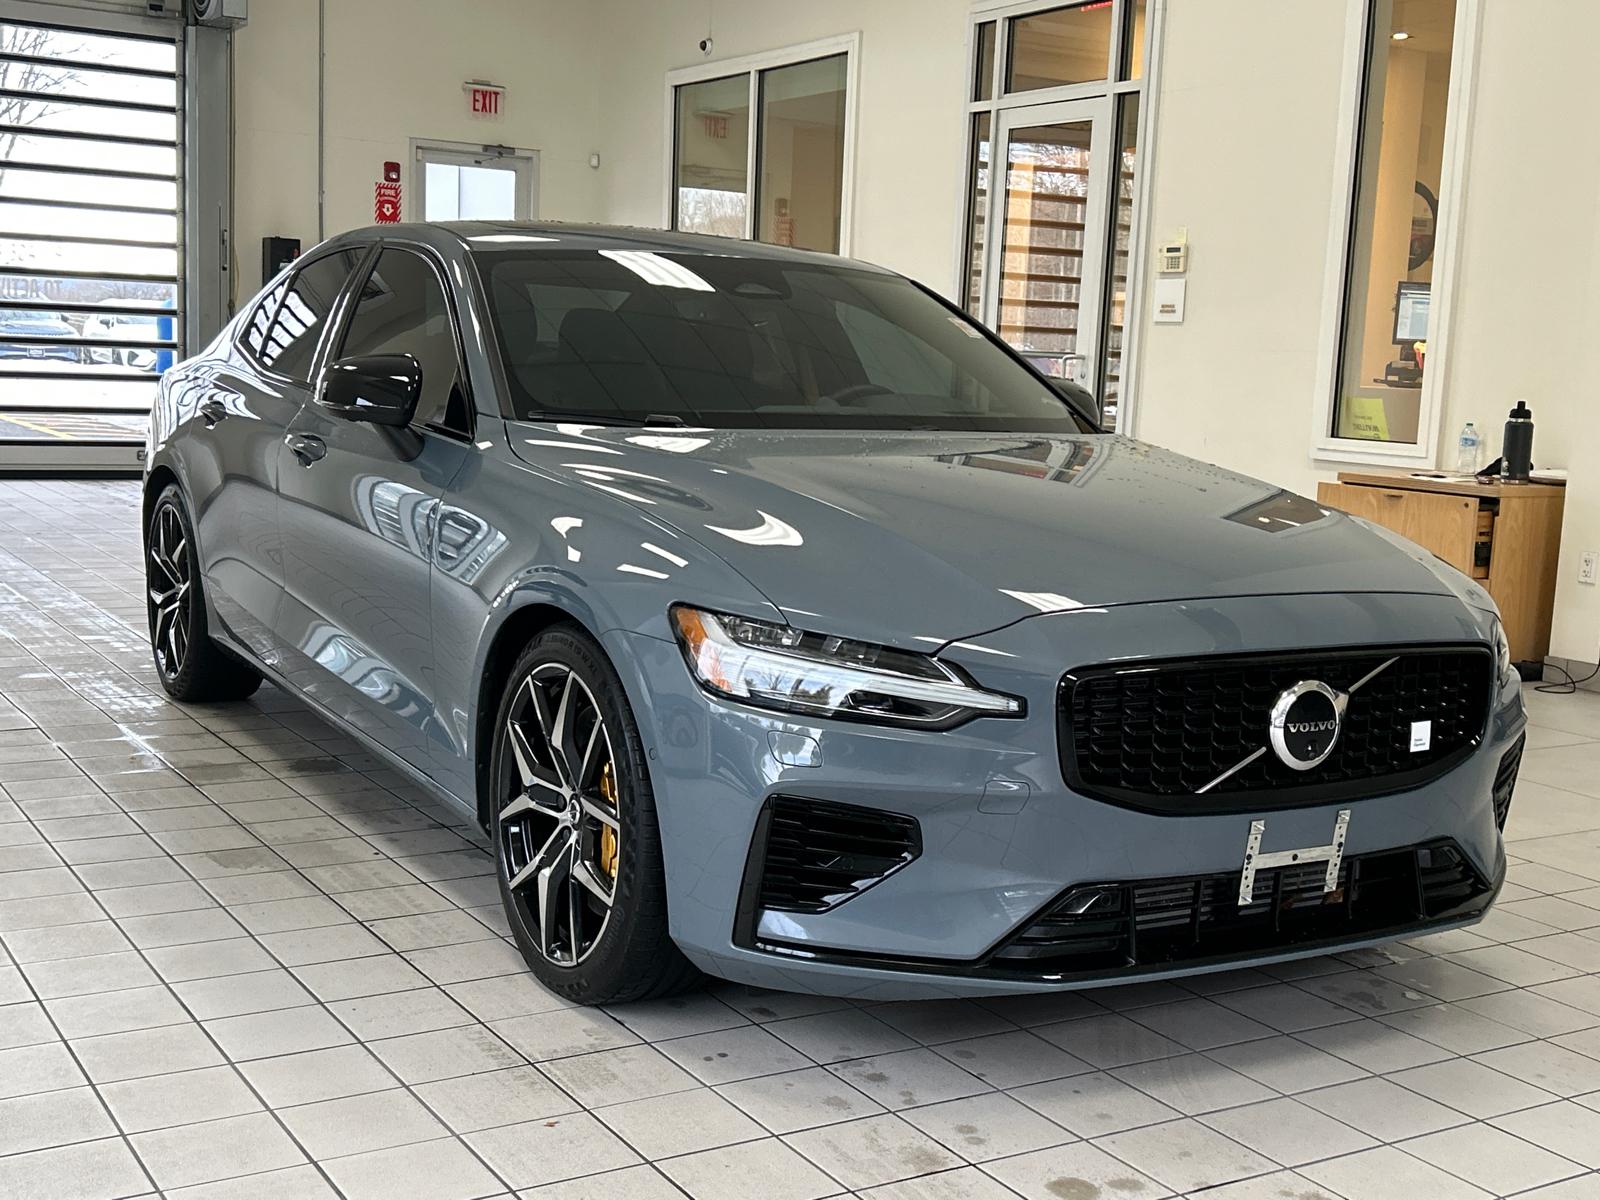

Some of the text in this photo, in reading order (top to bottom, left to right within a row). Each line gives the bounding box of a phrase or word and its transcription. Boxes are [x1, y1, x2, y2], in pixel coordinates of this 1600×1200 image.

[472, 89, 500, 114] EXIT
[380, 188, 396, 196] FIRE
[1287, 719, 1336, 733] VOLVO
